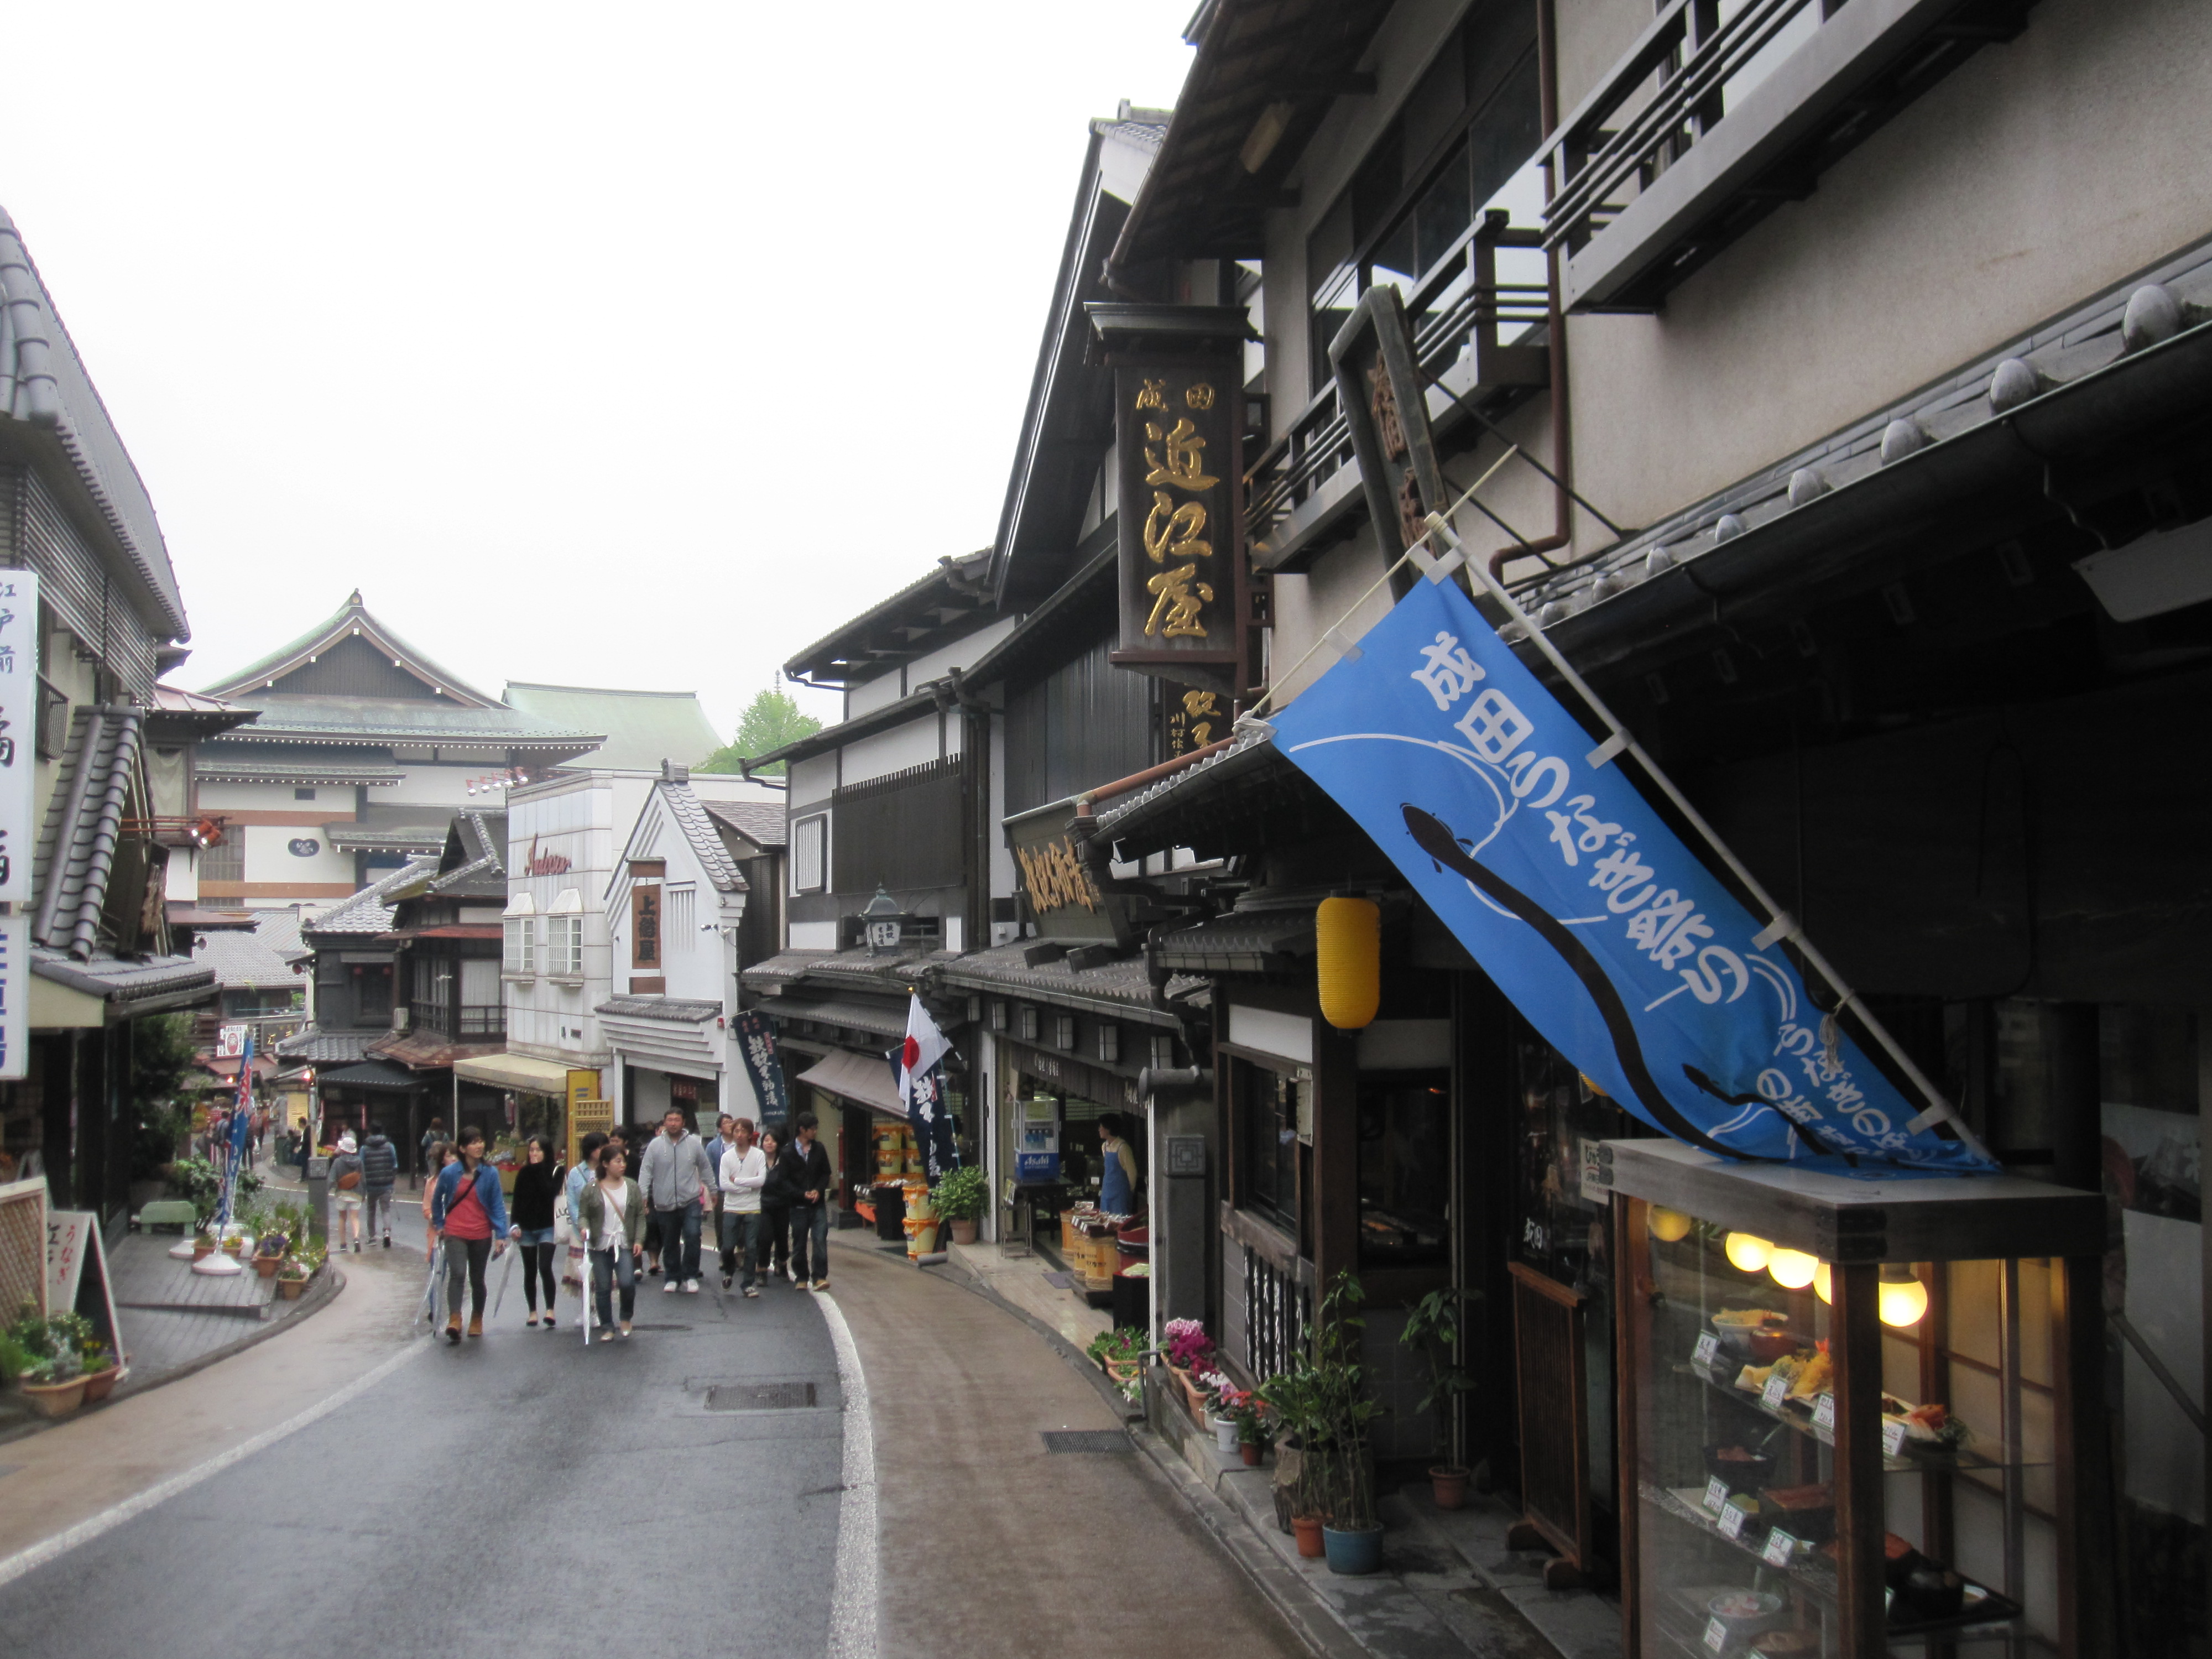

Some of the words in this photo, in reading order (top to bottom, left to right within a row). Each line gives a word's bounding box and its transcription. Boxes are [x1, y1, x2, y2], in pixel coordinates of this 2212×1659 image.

[1136, 378, 1215, 413] 成田
[1144, 416, 1220, 637] 近江屋
[1024, 1155, 1049, 1166] Asahi
[57, 1224, 76, 1286] うなぎ
